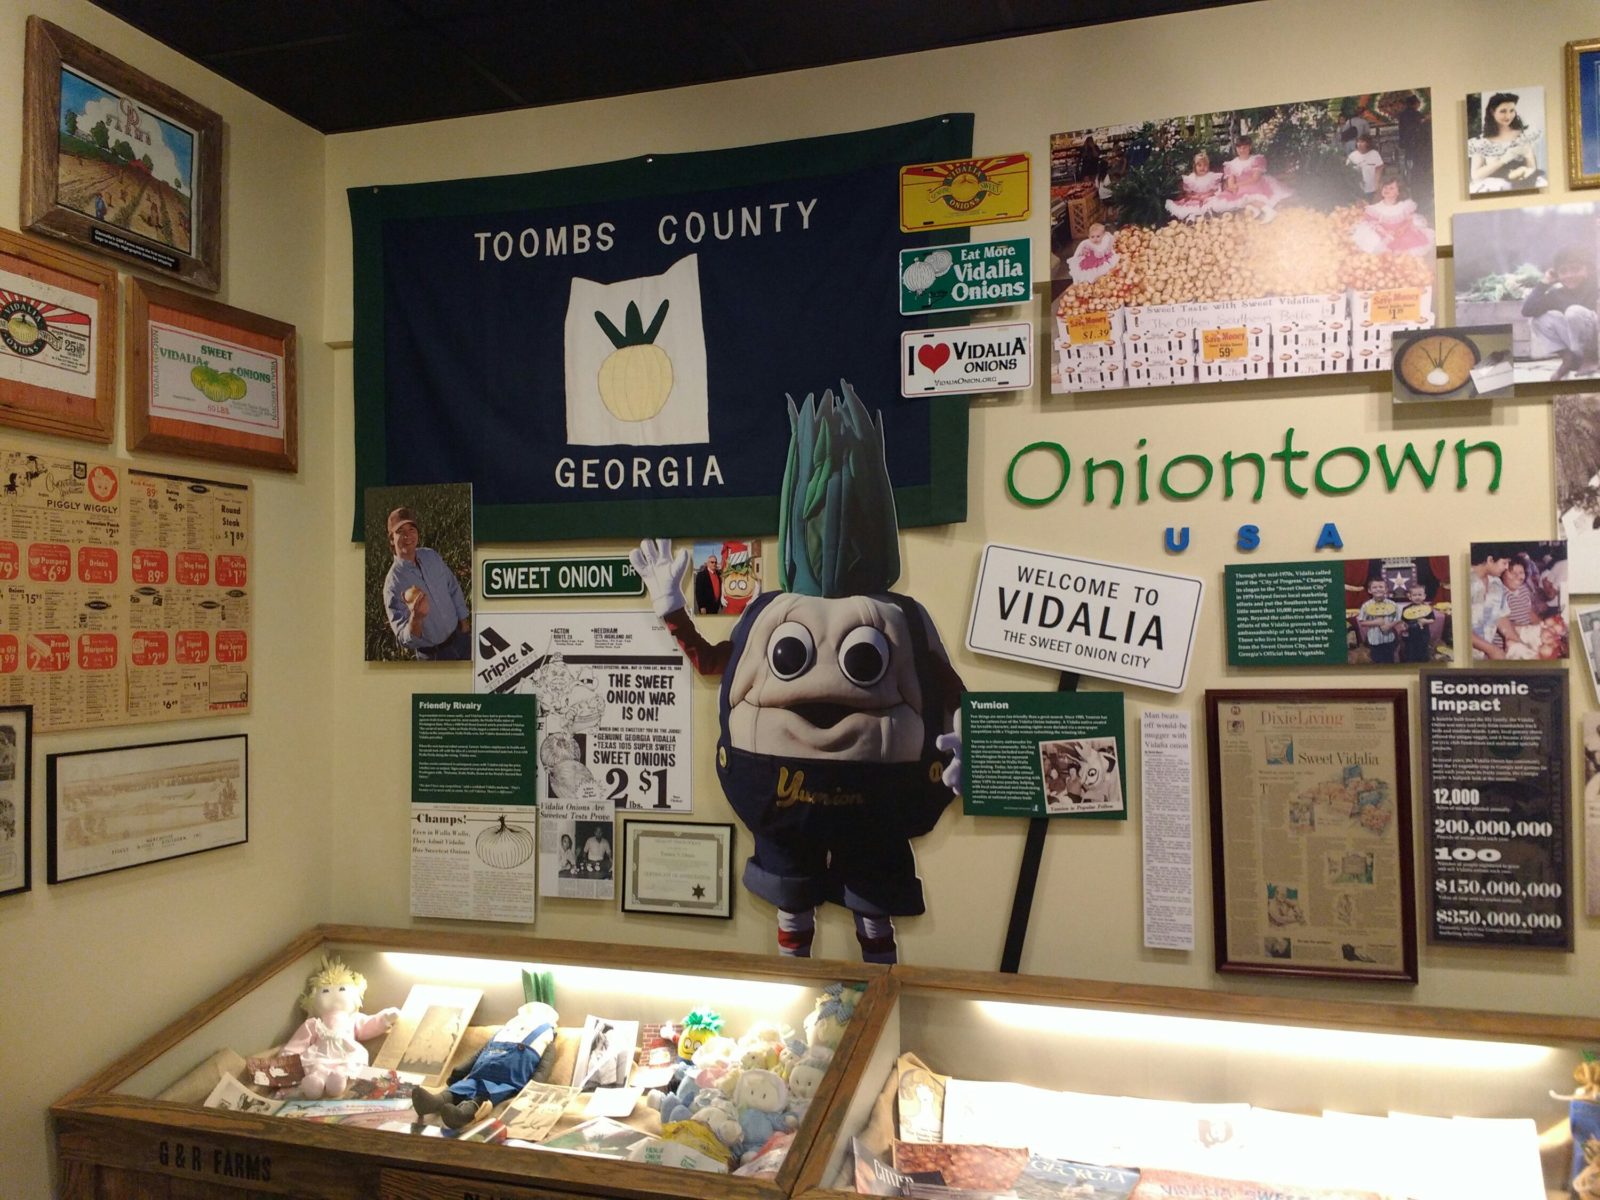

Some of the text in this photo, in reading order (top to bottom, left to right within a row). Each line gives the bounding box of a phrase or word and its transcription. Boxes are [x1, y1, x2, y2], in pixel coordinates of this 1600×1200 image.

[947, 166, 981, 180] VIDALIA
[980, 182, 999, 192] SWEET
[950, 198, 980, 209] ONIONS
[474, 198, 818, 262] TOOMBS COUNTY
[961, 245, 1016, 261] Eat More
[954, 260, 1024, 282] Vidalia
[952, 282, 1025, 302] Onions
[5, 303, 41, 322] VIDALIA
[1146, 305, 1175, 314] Sweet
[1180, 304, 1208, 312] Taste
[1241, 300, 1272, 308] Sweet
[40, 330, 59, 350] SWEET
[1083, 330, 1109, 339] $1.39
[1205, 332, 1246, 344] Save Money
[7, 338, 39, 354] ONIONS
[64, 340, 76, 352] 25
[201, 345, 233, 360] SWEET
[160, 347, 203, 366] VIDALIA
[908, 346, 915, 376] I
[964, 358, 1018, 374] ONIONS
[236, 367, 271, 383] ONIONS
[555, 455, 724, 489] GEORGIA
[1008, 428, 1502, 508] Oniontown
[47, 500, 118, 514] PIGGLY WIGGLY
[221, 505, 241, 514] Round
[222, 518, 240, 527] Steak
[1165, 522, 1344, 554] U S A
[40, 557, 68, 566] Pampers
[84, 570, 91, 581] 6
[491, 566, 550, 590] SWEET
[558, 564, 613, 588] ONION
[1018, 566, 1159, 606] WELCOME TO
[998, 587, 1164, 650] VIDALIA
[1003, 630, 1150, 669] THE SWEET ONION CITY
[30, 652, 39, 670] 2
[478, 653, 518, 684] Triple
[608, 674, 675, 690] THE SWEET
[1430, 681, 1529, 695] Economic
[606, 690, 676, 706] ONION WAR
[970, 701, 1009, 710] Yumion
[1431, 697, 1501, 713] Impact
[419, 702, 482, 711] Friendly Rivalry
[622, 706, 659, 721] IS ON!
[1262, 711, 1343, 726] Dixie Living
[593, 751, 676, 767] SWEET ONIONS
[1299, 752, 1379, 765] Sweet Vidalia
[606, 768, 628, 808] 2
[639, 768, 671, 808] $1
[1433, 788, 1480, 806] 12,000
[540, 803, 563, 812] Vidalia
[566, 803, 590, 811] Onions
[417, 813, 466, 826] Champs!
[1434, 819, 1552, 837] 200,000,000
[1434, 847, 1502, 862] 100
[1436, 879, 1562, 899] $150,000,000
[1436, 909, 1562, 928] $350,000,000
[159, 1142, 272, 1182] G & R FARMS
[1032, 1159, 1126, 1184] GEORGIA
